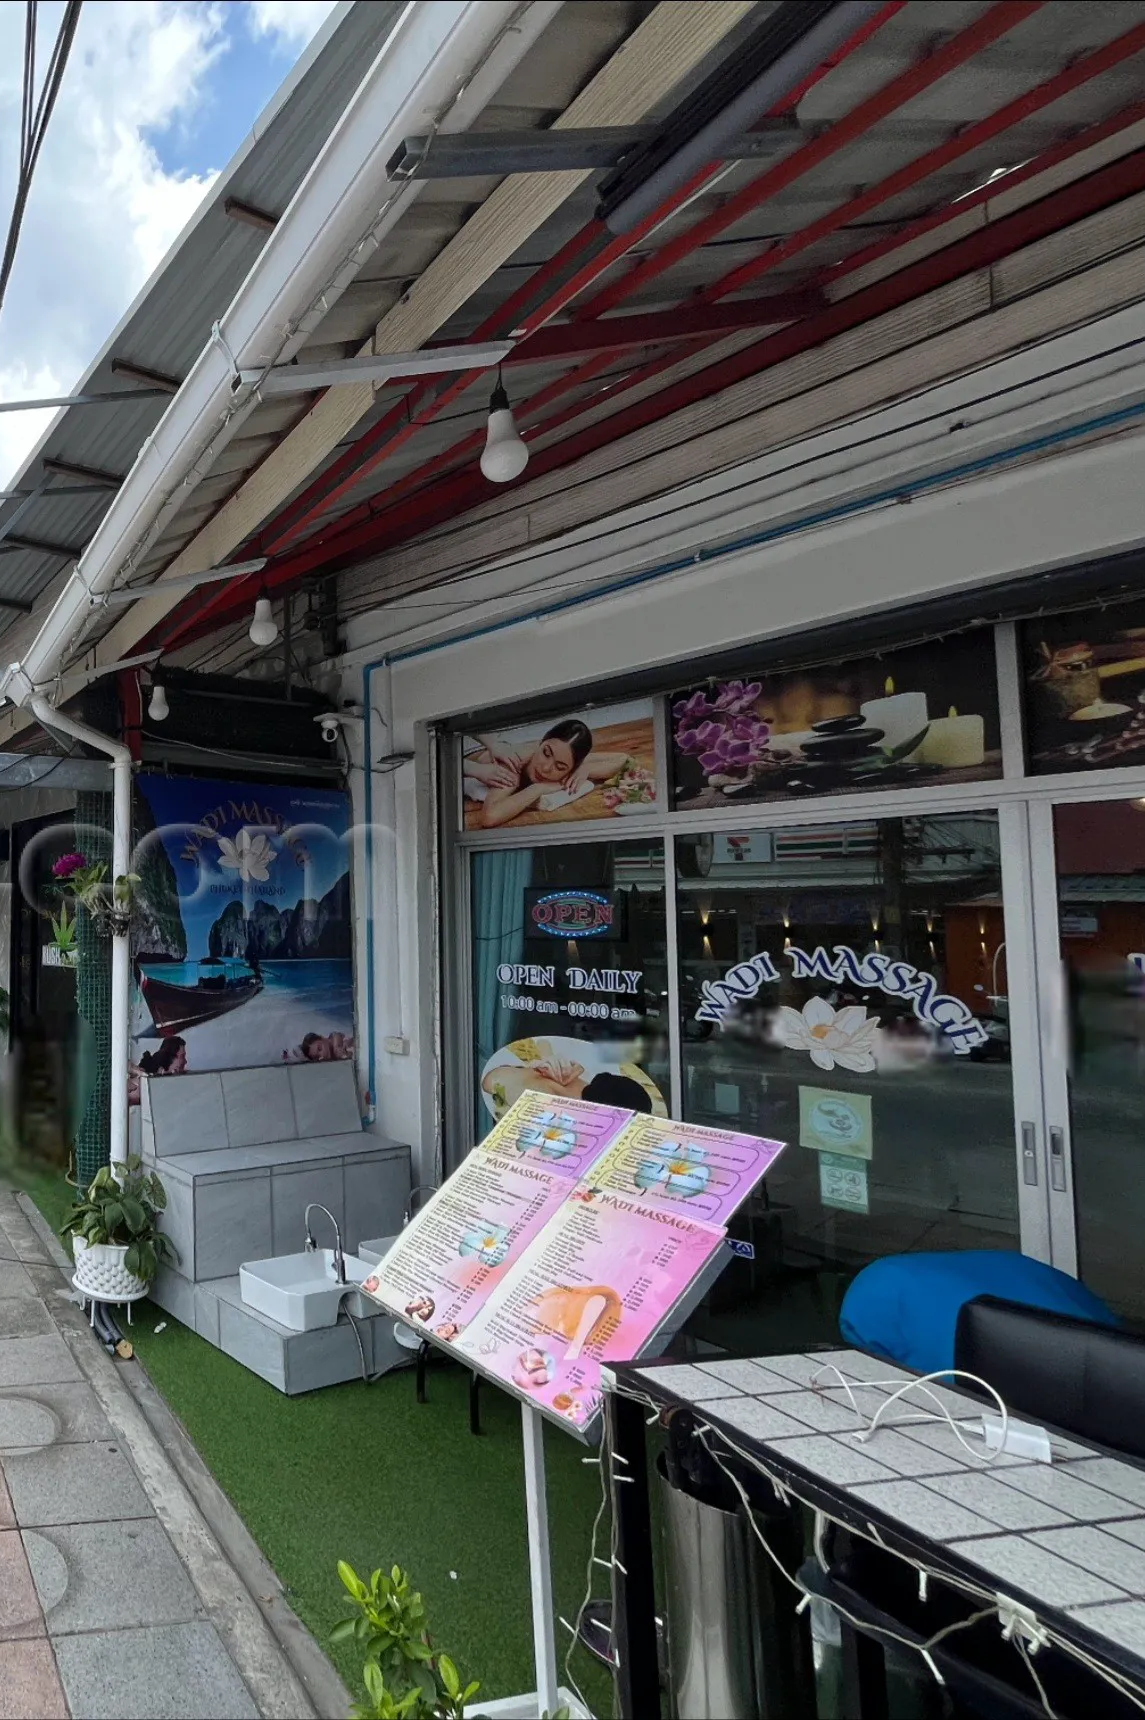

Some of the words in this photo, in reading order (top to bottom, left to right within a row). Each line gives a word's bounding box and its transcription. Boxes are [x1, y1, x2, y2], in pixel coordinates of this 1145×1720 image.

[532, 903, 615, 924] OPEN
[496, 963, 556, 988] OPEN
[566, 967, 643, 994] DAILY
[500, 994, 534, 1010] 10:00
[536, 1000, 559, 1014] am
[567, 1002, 609, 1019] 00:00
[695, 951, 781, 1031] WADI
[785, 945, 989, 1056] MASSAGE
[697, 1129, 735, 1141] MASSAGE
[484, 1157, 510, 1173] WADI
[509, 1166, 554, 1185] MASSAGE
[599, 1193, 632, 1212] WADI
[634, 1207, 696, 1234] MASSAGE
